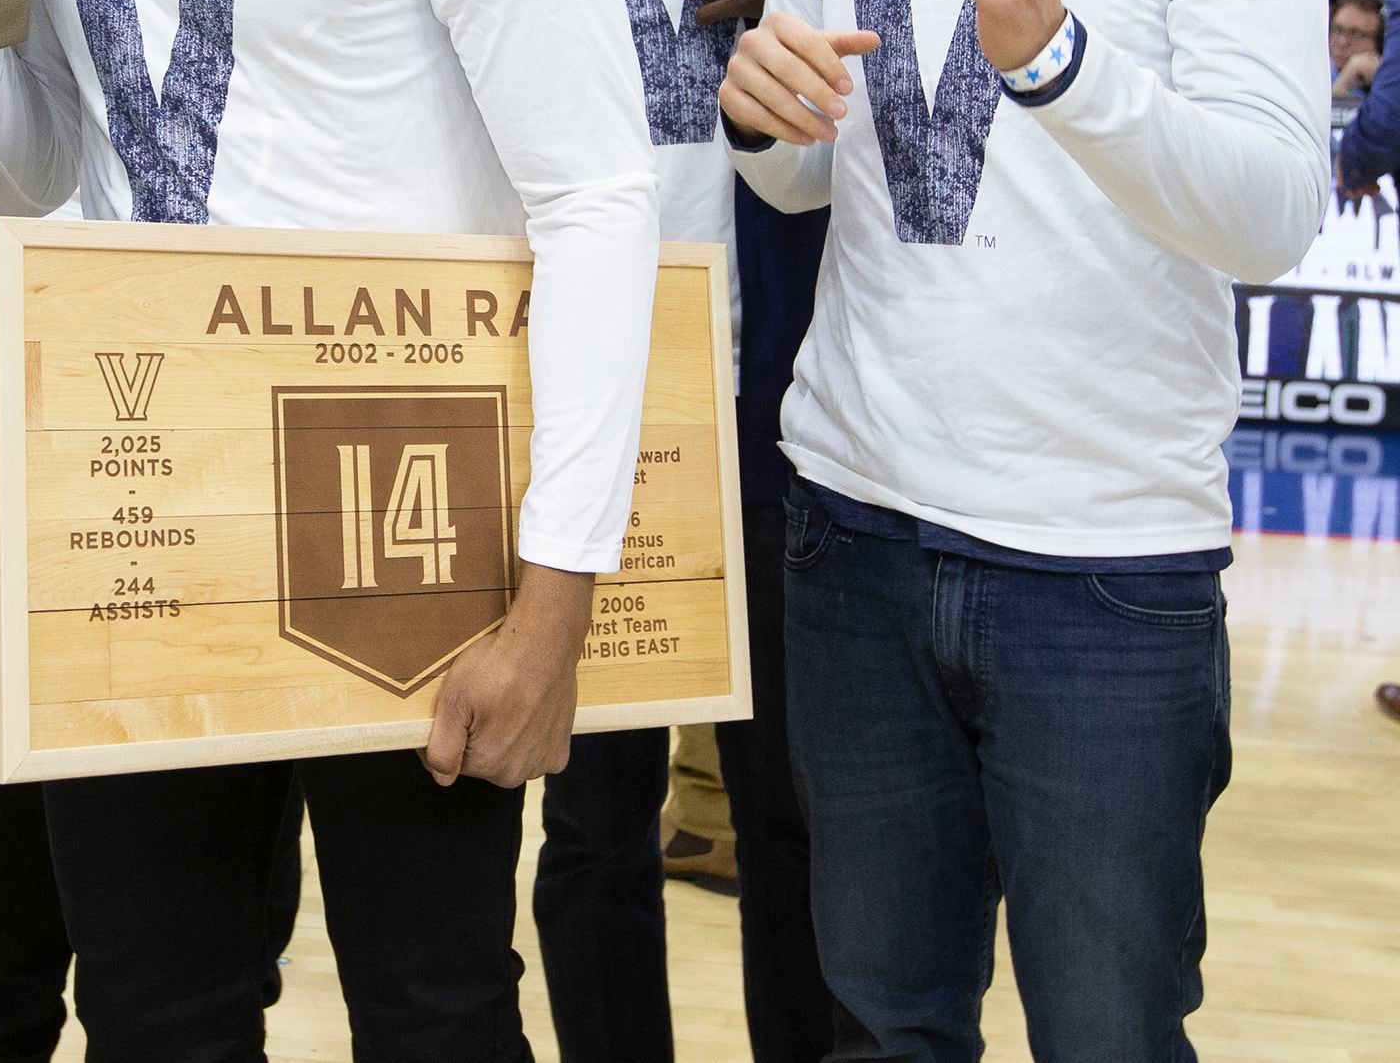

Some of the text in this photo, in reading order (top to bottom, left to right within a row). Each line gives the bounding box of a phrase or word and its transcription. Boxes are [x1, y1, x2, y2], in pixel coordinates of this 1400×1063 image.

[974, 234, 997, 249] TM
[206, 284, 531, 337] ALLAN RA
[315, 343, 378, 364] 2002
[404, 343, 464, 365] 2006
[94, 352, 165, 421] V
[1238, 378, 1386, 425] EICO
[101, 435, 162, 456] 2,025
[637, 446, 681, 464] ward
[90, 458, 173, 477] POINTS
[112, 506, 154, 524] 459
[336, 443, 457, 589] 14
[70, 528, 196, 550] REBOUNDS
[114, 577, 155, 596] 244
[89, 599, 181, 622] ASSISTS
[600, 596, 645, 614] 2006
[590, 617, 668, 636] irst Team
[579, 637, 680, 660] ll-BIG EAST
